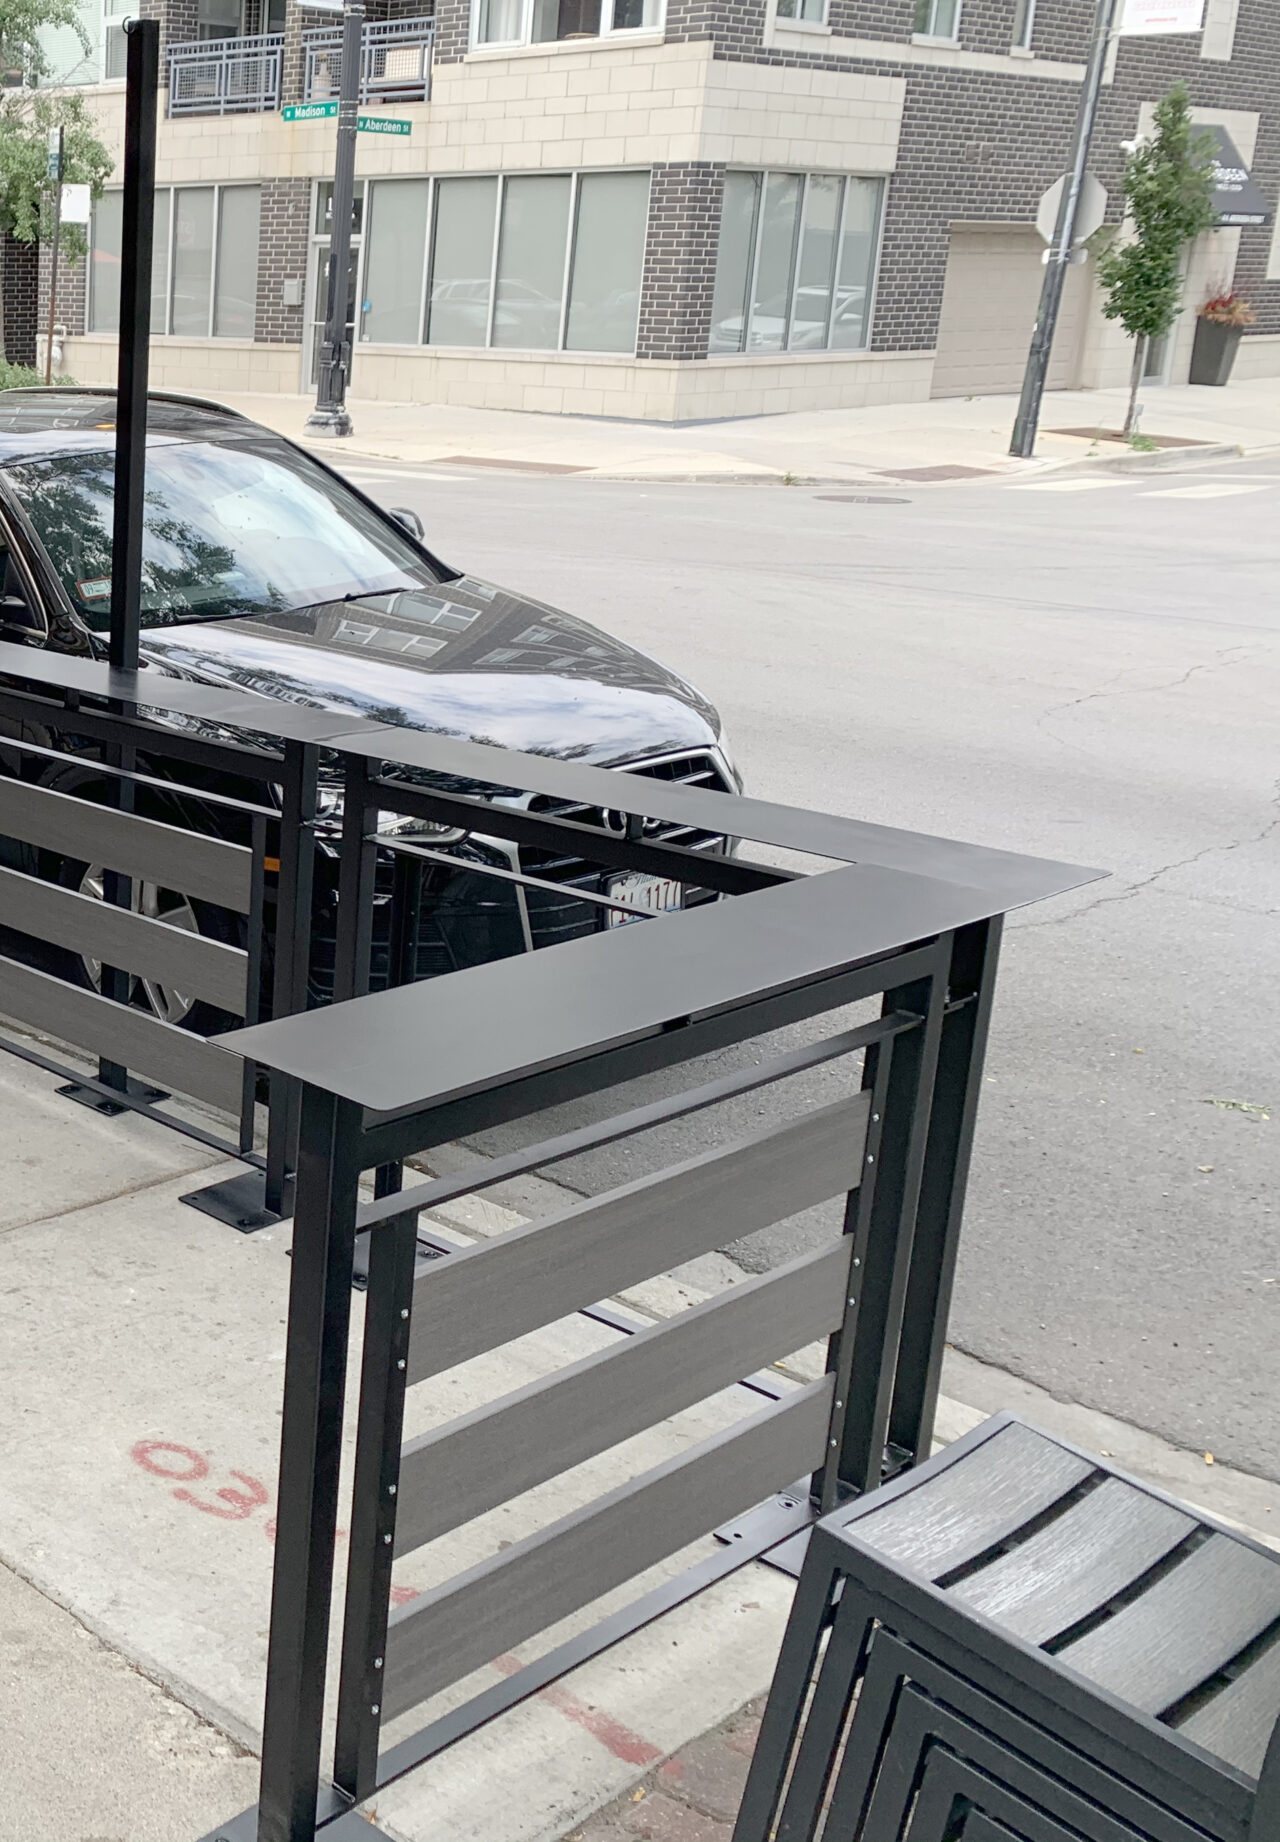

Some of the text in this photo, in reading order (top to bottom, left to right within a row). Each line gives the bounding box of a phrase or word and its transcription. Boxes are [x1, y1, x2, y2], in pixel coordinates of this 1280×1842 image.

[294, 106, 326, 118] Madison
[329, 106, 336, 114] St
[365, 119, 402, 132] Aberdeen
[403, 124, 409, 132] St
